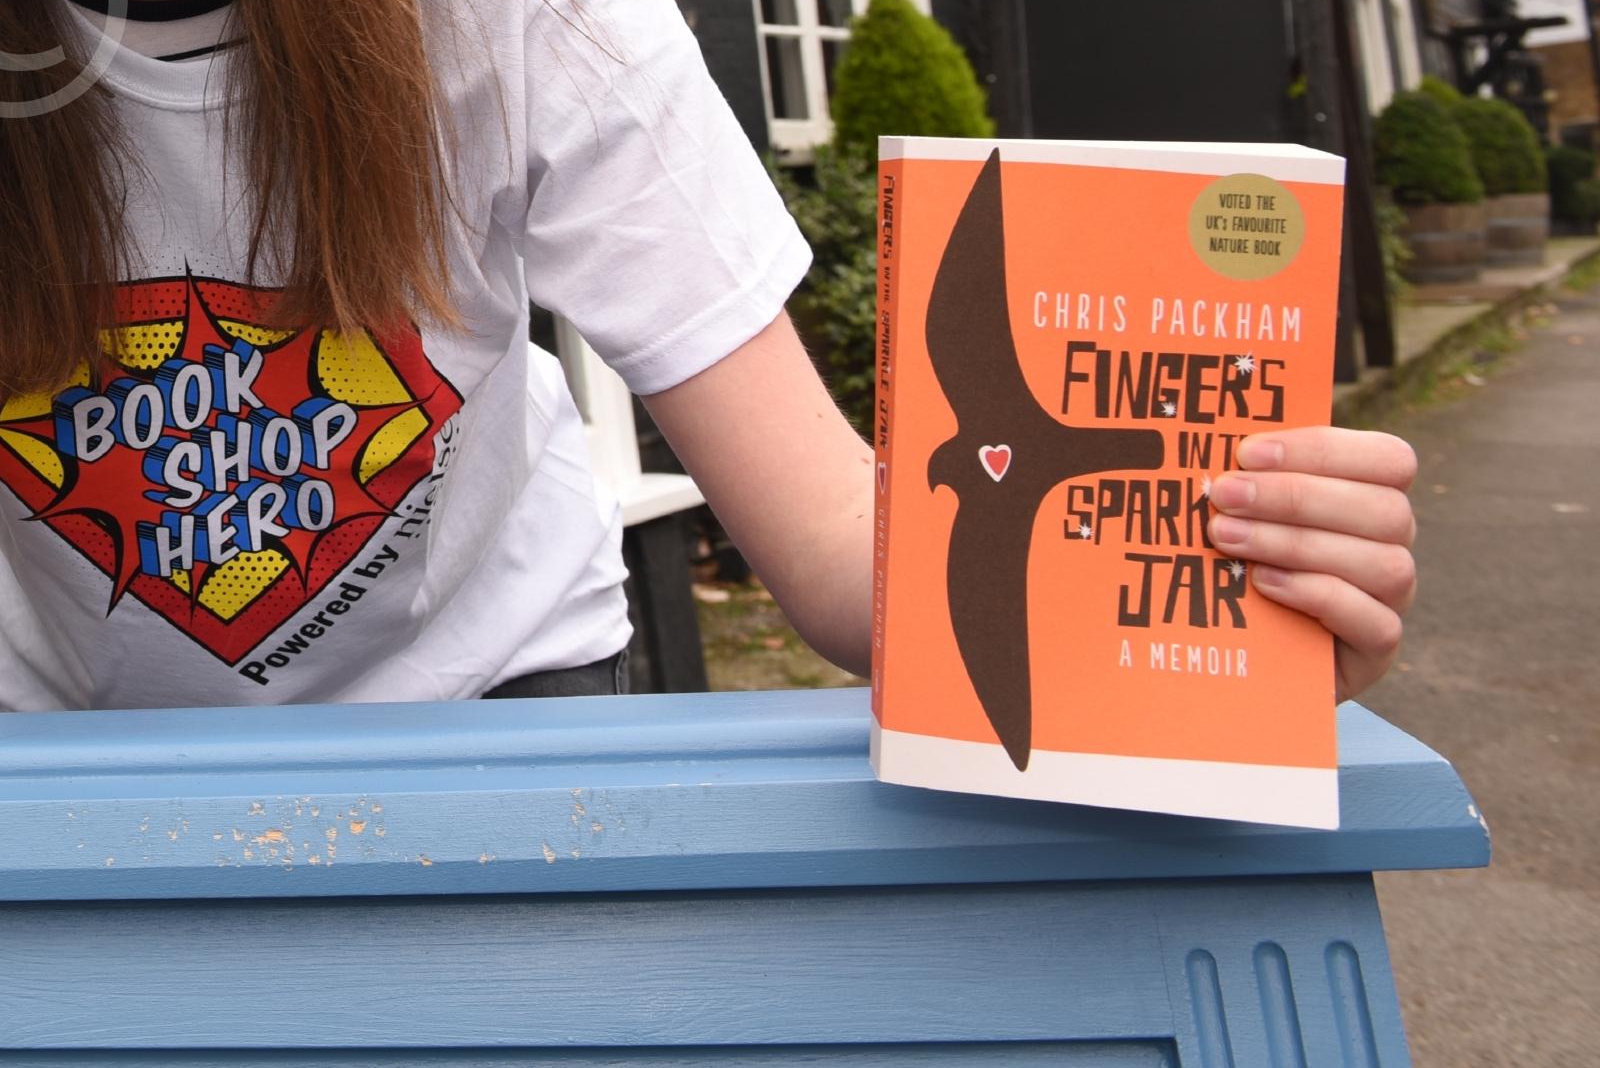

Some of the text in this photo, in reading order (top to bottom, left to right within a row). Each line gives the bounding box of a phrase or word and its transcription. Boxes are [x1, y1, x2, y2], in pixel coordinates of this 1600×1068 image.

[883, 175, 895, 260] FINGERS
[1219, 193, 1276, 210] VOTED THE
[1232, 216, 1287, 234] FAVOURITE
[1209, 237, 1281, 256] NATURE BOOK
[880, 309, 891, 389] SPARKLE
[1033, 291, 1301, 342] CHRIS PACKHAM
[63, 343, 265, 463] BOOK
[1061, 340, 1285, 424] FINGERS
[152, 399, 358, 509] SHOP
[879, 398, 889, 449] JAR
[1178, 431, 1212, 470] IN
[146, 476, 336, 578] HERO
[1063, 477, 1216, 549] SPARK
[238, 582, 368, 686] Powered
[353, 544, 399, 579] by
[1117, 552, 1248, 630] JAR
[1119, 639, 1247, 677] A MEMOIR
